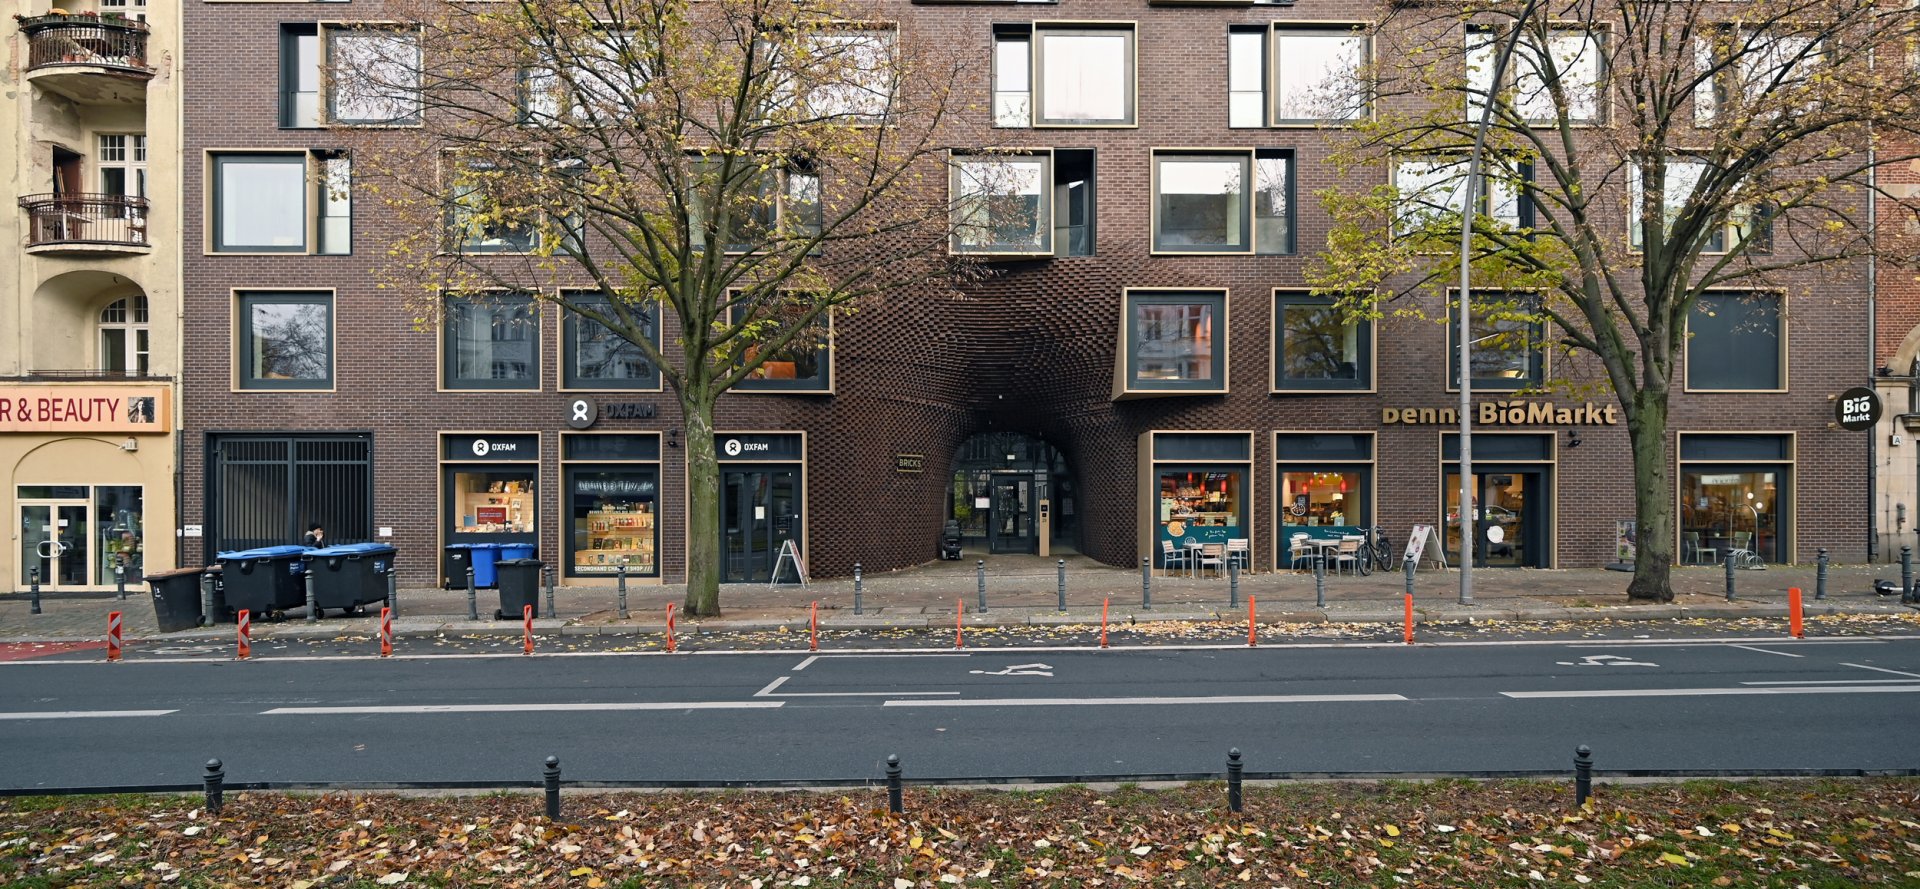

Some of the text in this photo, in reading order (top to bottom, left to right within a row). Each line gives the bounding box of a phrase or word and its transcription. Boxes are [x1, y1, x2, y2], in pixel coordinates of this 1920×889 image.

[17, 397, 32, 422] &
[38, 398, 120, 422] BEAUTY
[608, 403, 656, 418] OXFAM
[1842, 413, 1871, 423] Markt
[491, 443, 517, 451] OXFAM
[744, 443, 769, 451] OXFAM
[899, 459, 921, 468] BRICKS
